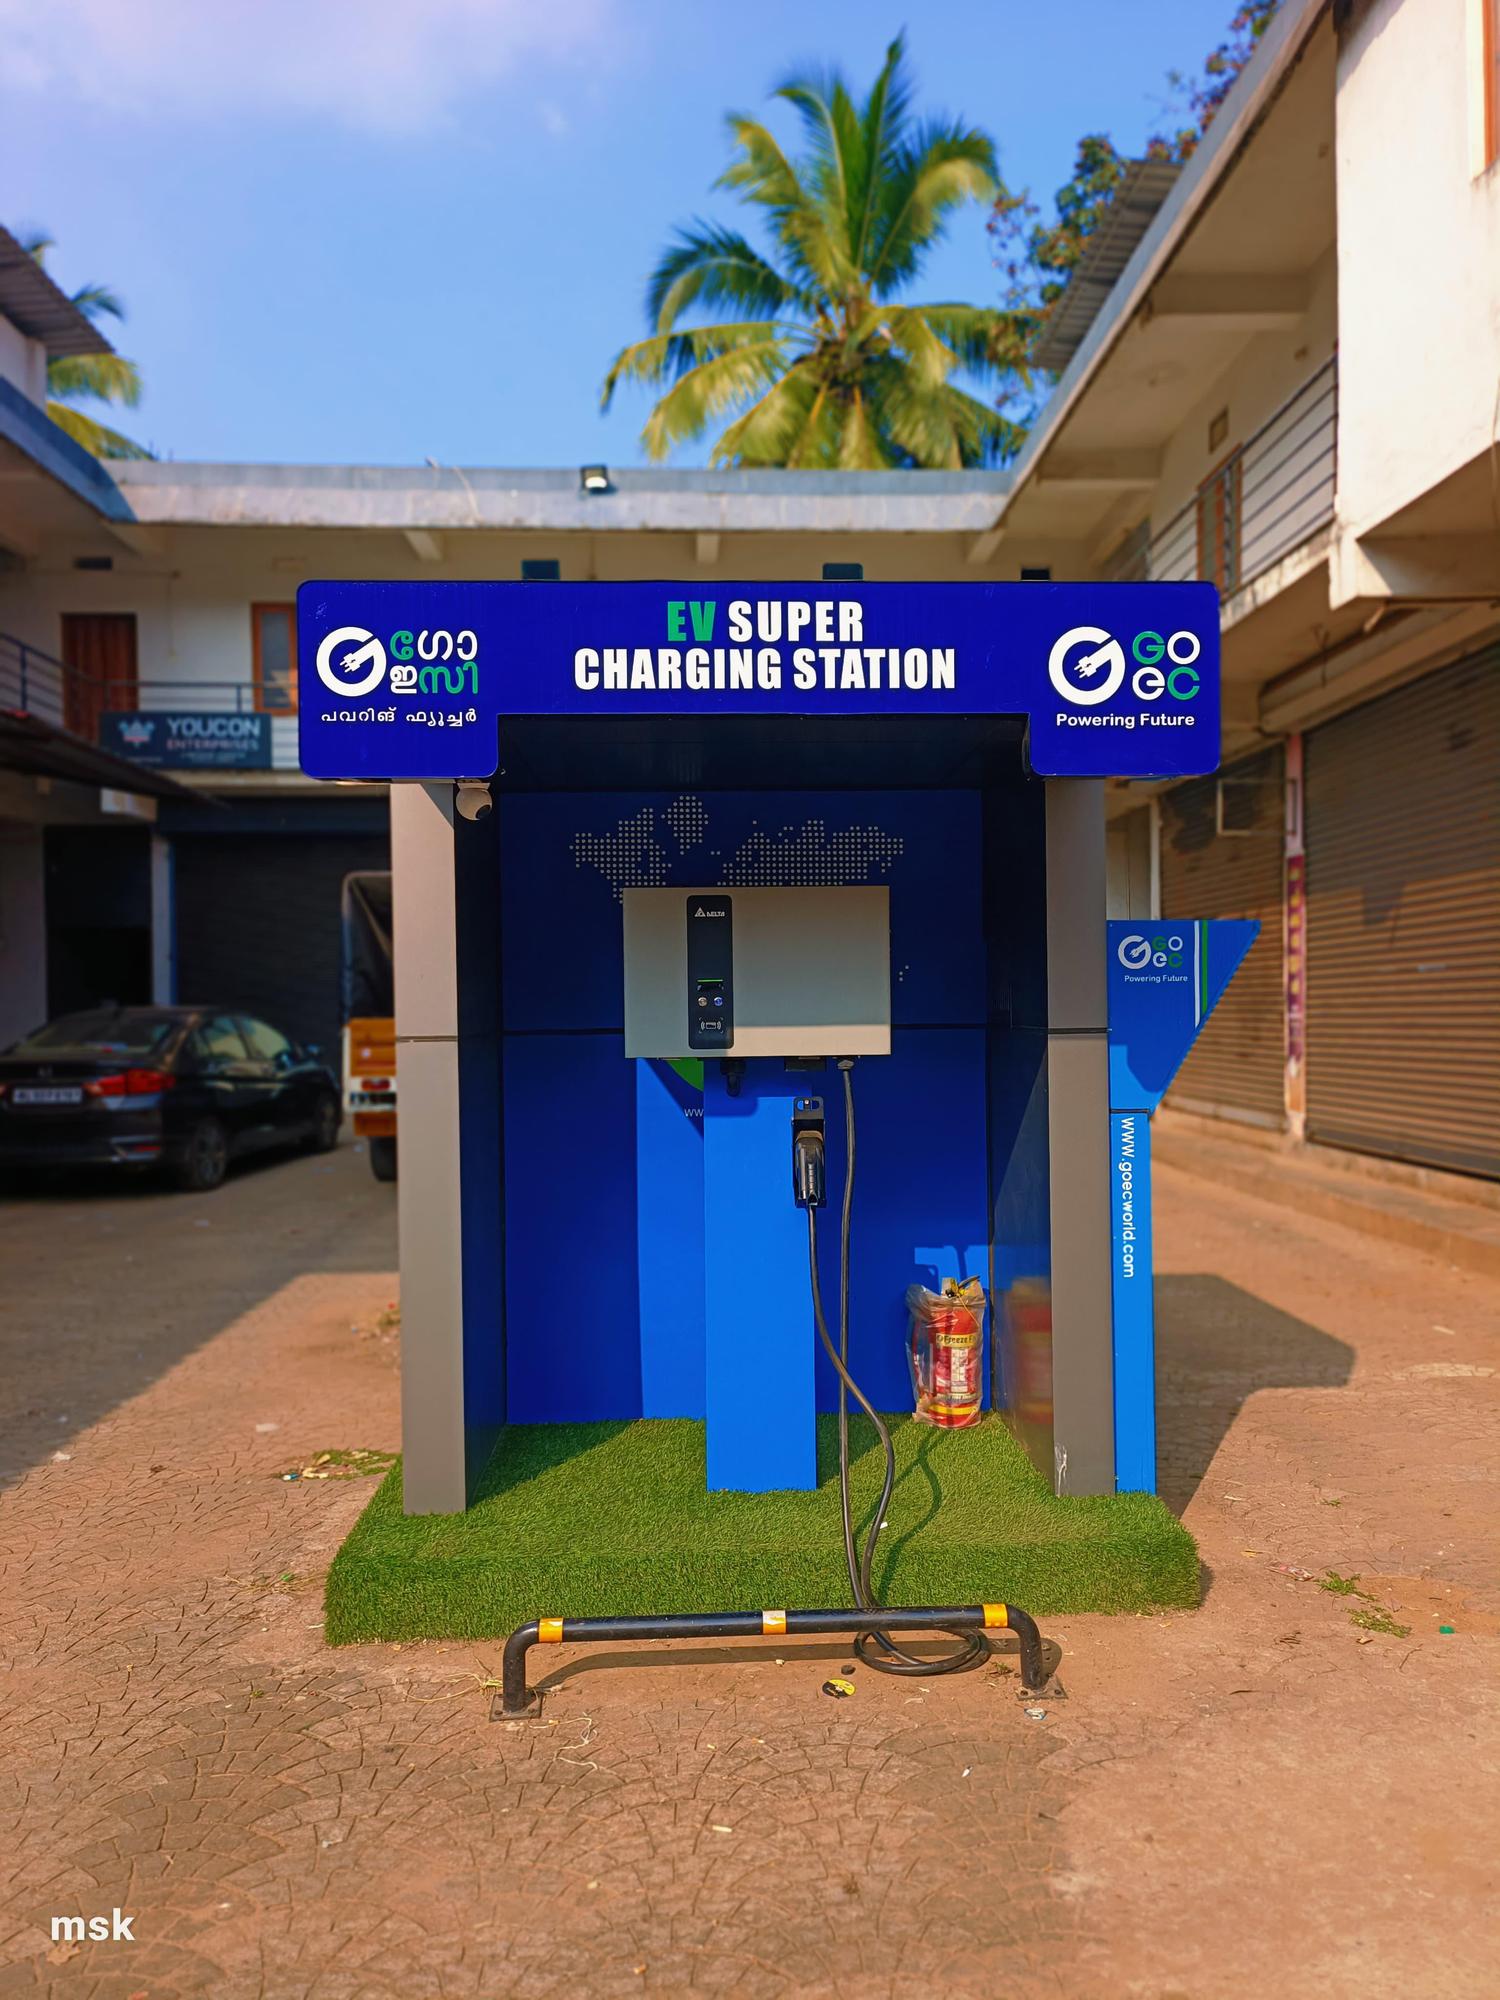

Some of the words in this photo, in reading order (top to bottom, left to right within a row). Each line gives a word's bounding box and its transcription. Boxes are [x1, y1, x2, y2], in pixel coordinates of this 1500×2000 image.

[667, 601, 716, 642] EV
[728, 600, 863, 642] SUPER
[390, 630, 478, 660] ഗോ
[1132, 630, 1201, 665] GO
[389, 661, 479, 695] ഇസി
[574, 648, 782, 690] CHARGING
[793, 648, 955, 690] STATION
[166, 717, 260, 737] YOUCON
[1056, 713, 1135, 729] Powering
[1140, 713, 1195, 726] Future
[1152, 936, 1183, 951] GO
[1124, 975, 1161, 983] Powering
